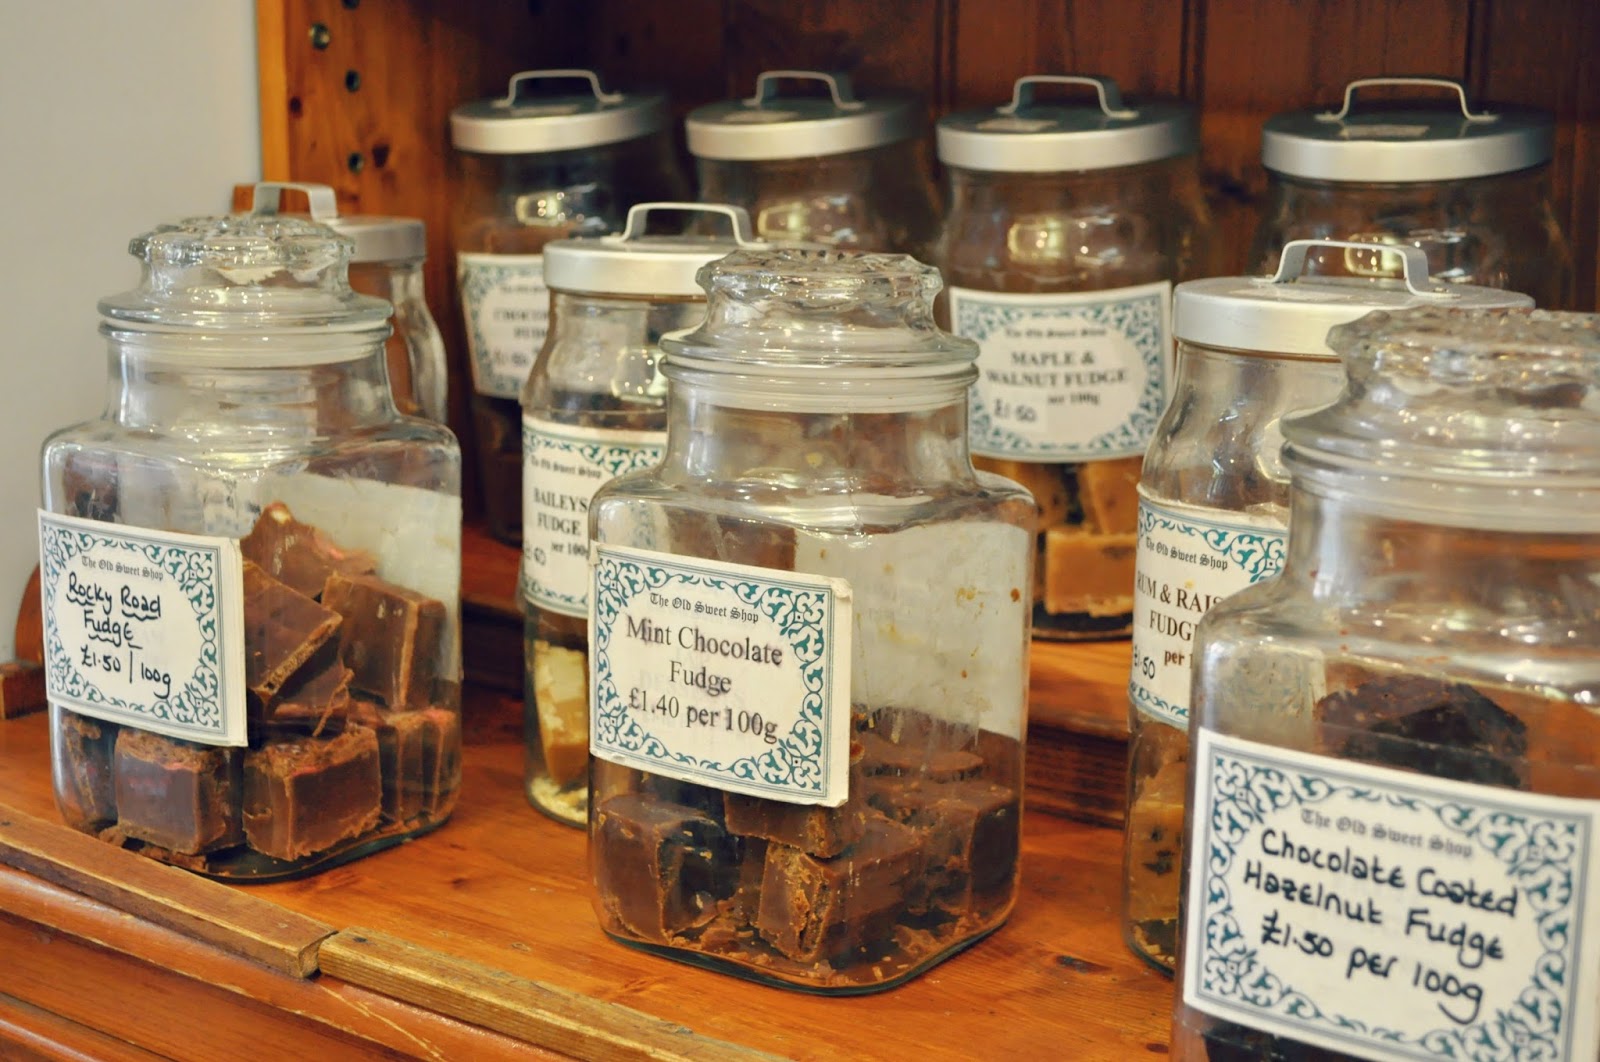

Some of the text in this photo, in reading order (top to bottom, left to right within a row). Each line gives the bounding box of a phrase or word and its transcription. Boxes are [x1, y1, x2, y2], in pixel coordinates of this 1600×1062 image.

[1011, 352, 1095, 366] MAPLE &
[986, 369, 1127, 387] WALNUT FUDGE
[534, 487, 588, 513] BAILEYS
[537, 512, 581, 536] FUDGE
[81, 555, 164, 581] The Old Sweet Shop
[1170, 547, 1197, 565] Sweet
[1199, 555, 1228, 571] Shop
[68, 571, 162, 618] Rocky Road
[1137, 570, 1157, 600] RUM
[1160, 583, 1172, 605] &
[650, 592, 759, 624] The Old Sweet Shop
[83, 609, 134, 646] Fudge
[626, 615, 783, 666] Mint Chocolate
[1164, 649, 1185, 667] per
[669, 660, 732, 697] Fudge
[628, 688, 778, 745] £1.40 per 100g
[1300, 808, 1473, 858] The Old Sweet Shop
[1260, 828, 1519, 918] Chocolate Coated
[1243, 861, 1505, 969] Hazelnut Fudge
[1260, 910, 1484, 1026] £1.50 per 100g
